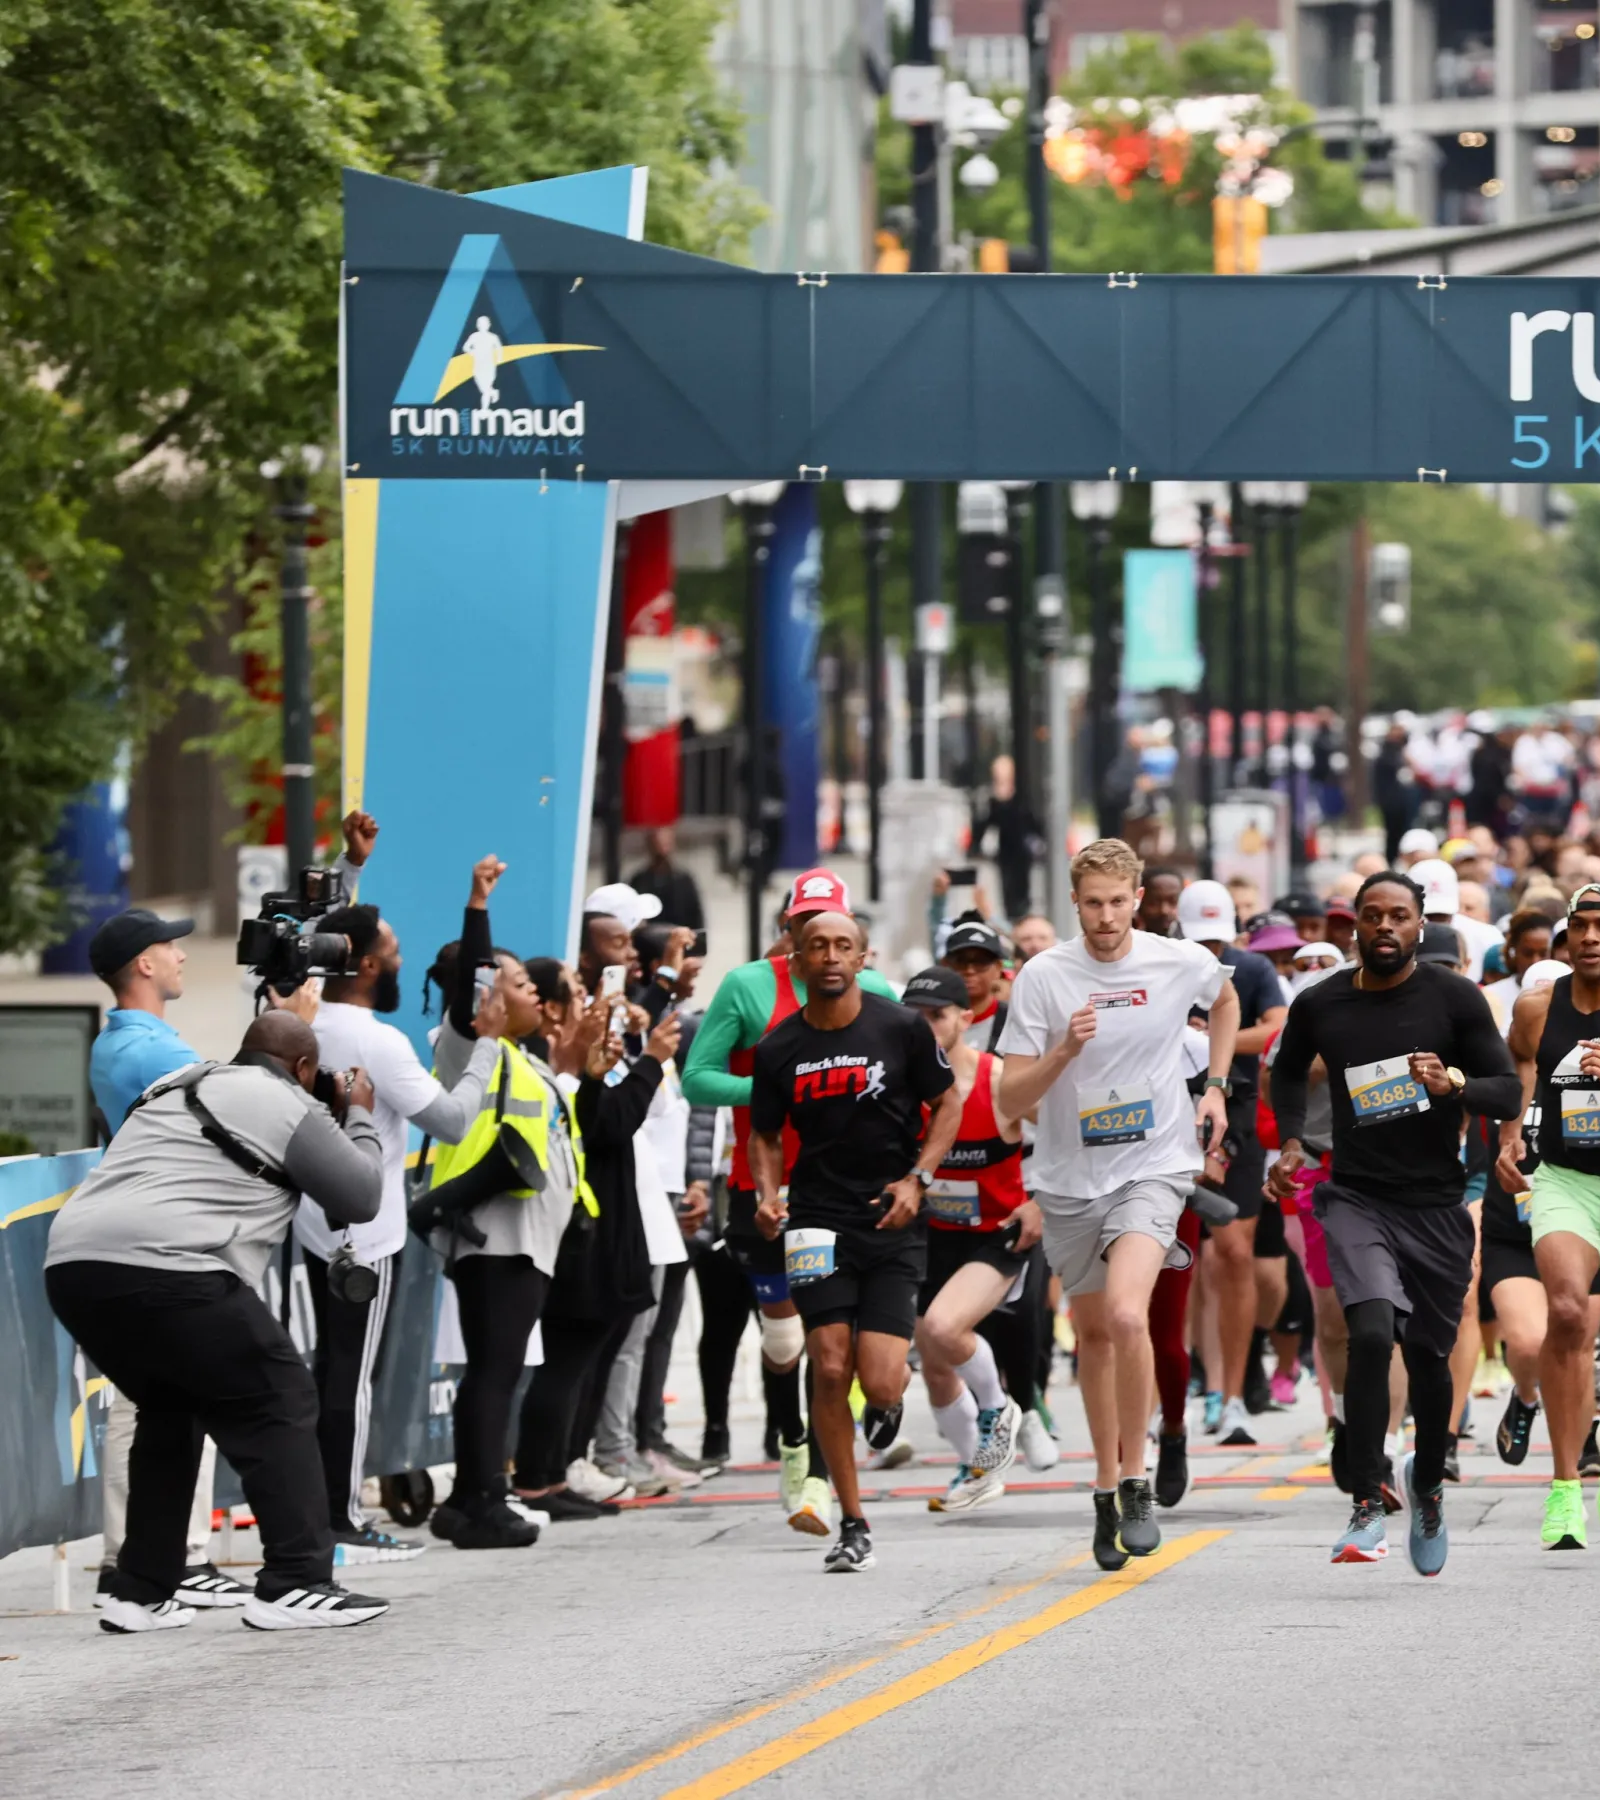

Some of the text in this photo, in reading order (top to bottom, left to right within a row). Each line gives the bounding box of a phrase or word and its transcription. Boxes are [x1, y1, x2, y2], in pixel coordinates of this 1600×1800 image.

[390, 408, 459, 436] run
[471, 400, 585, 437] maud
[392, 438, 583, 457] 5K RUN/WALK
[796, 1055, 868, 1076] Black Men
[793, 1065, 866, 1104] run
[1550, 1076, 1580, 1084] PACERS
[1358, 1082, 1417, 1109] B3685
[1087, 1109, 1147, 1132] A3247
[943, 1149, 987, 1161] LANTA
